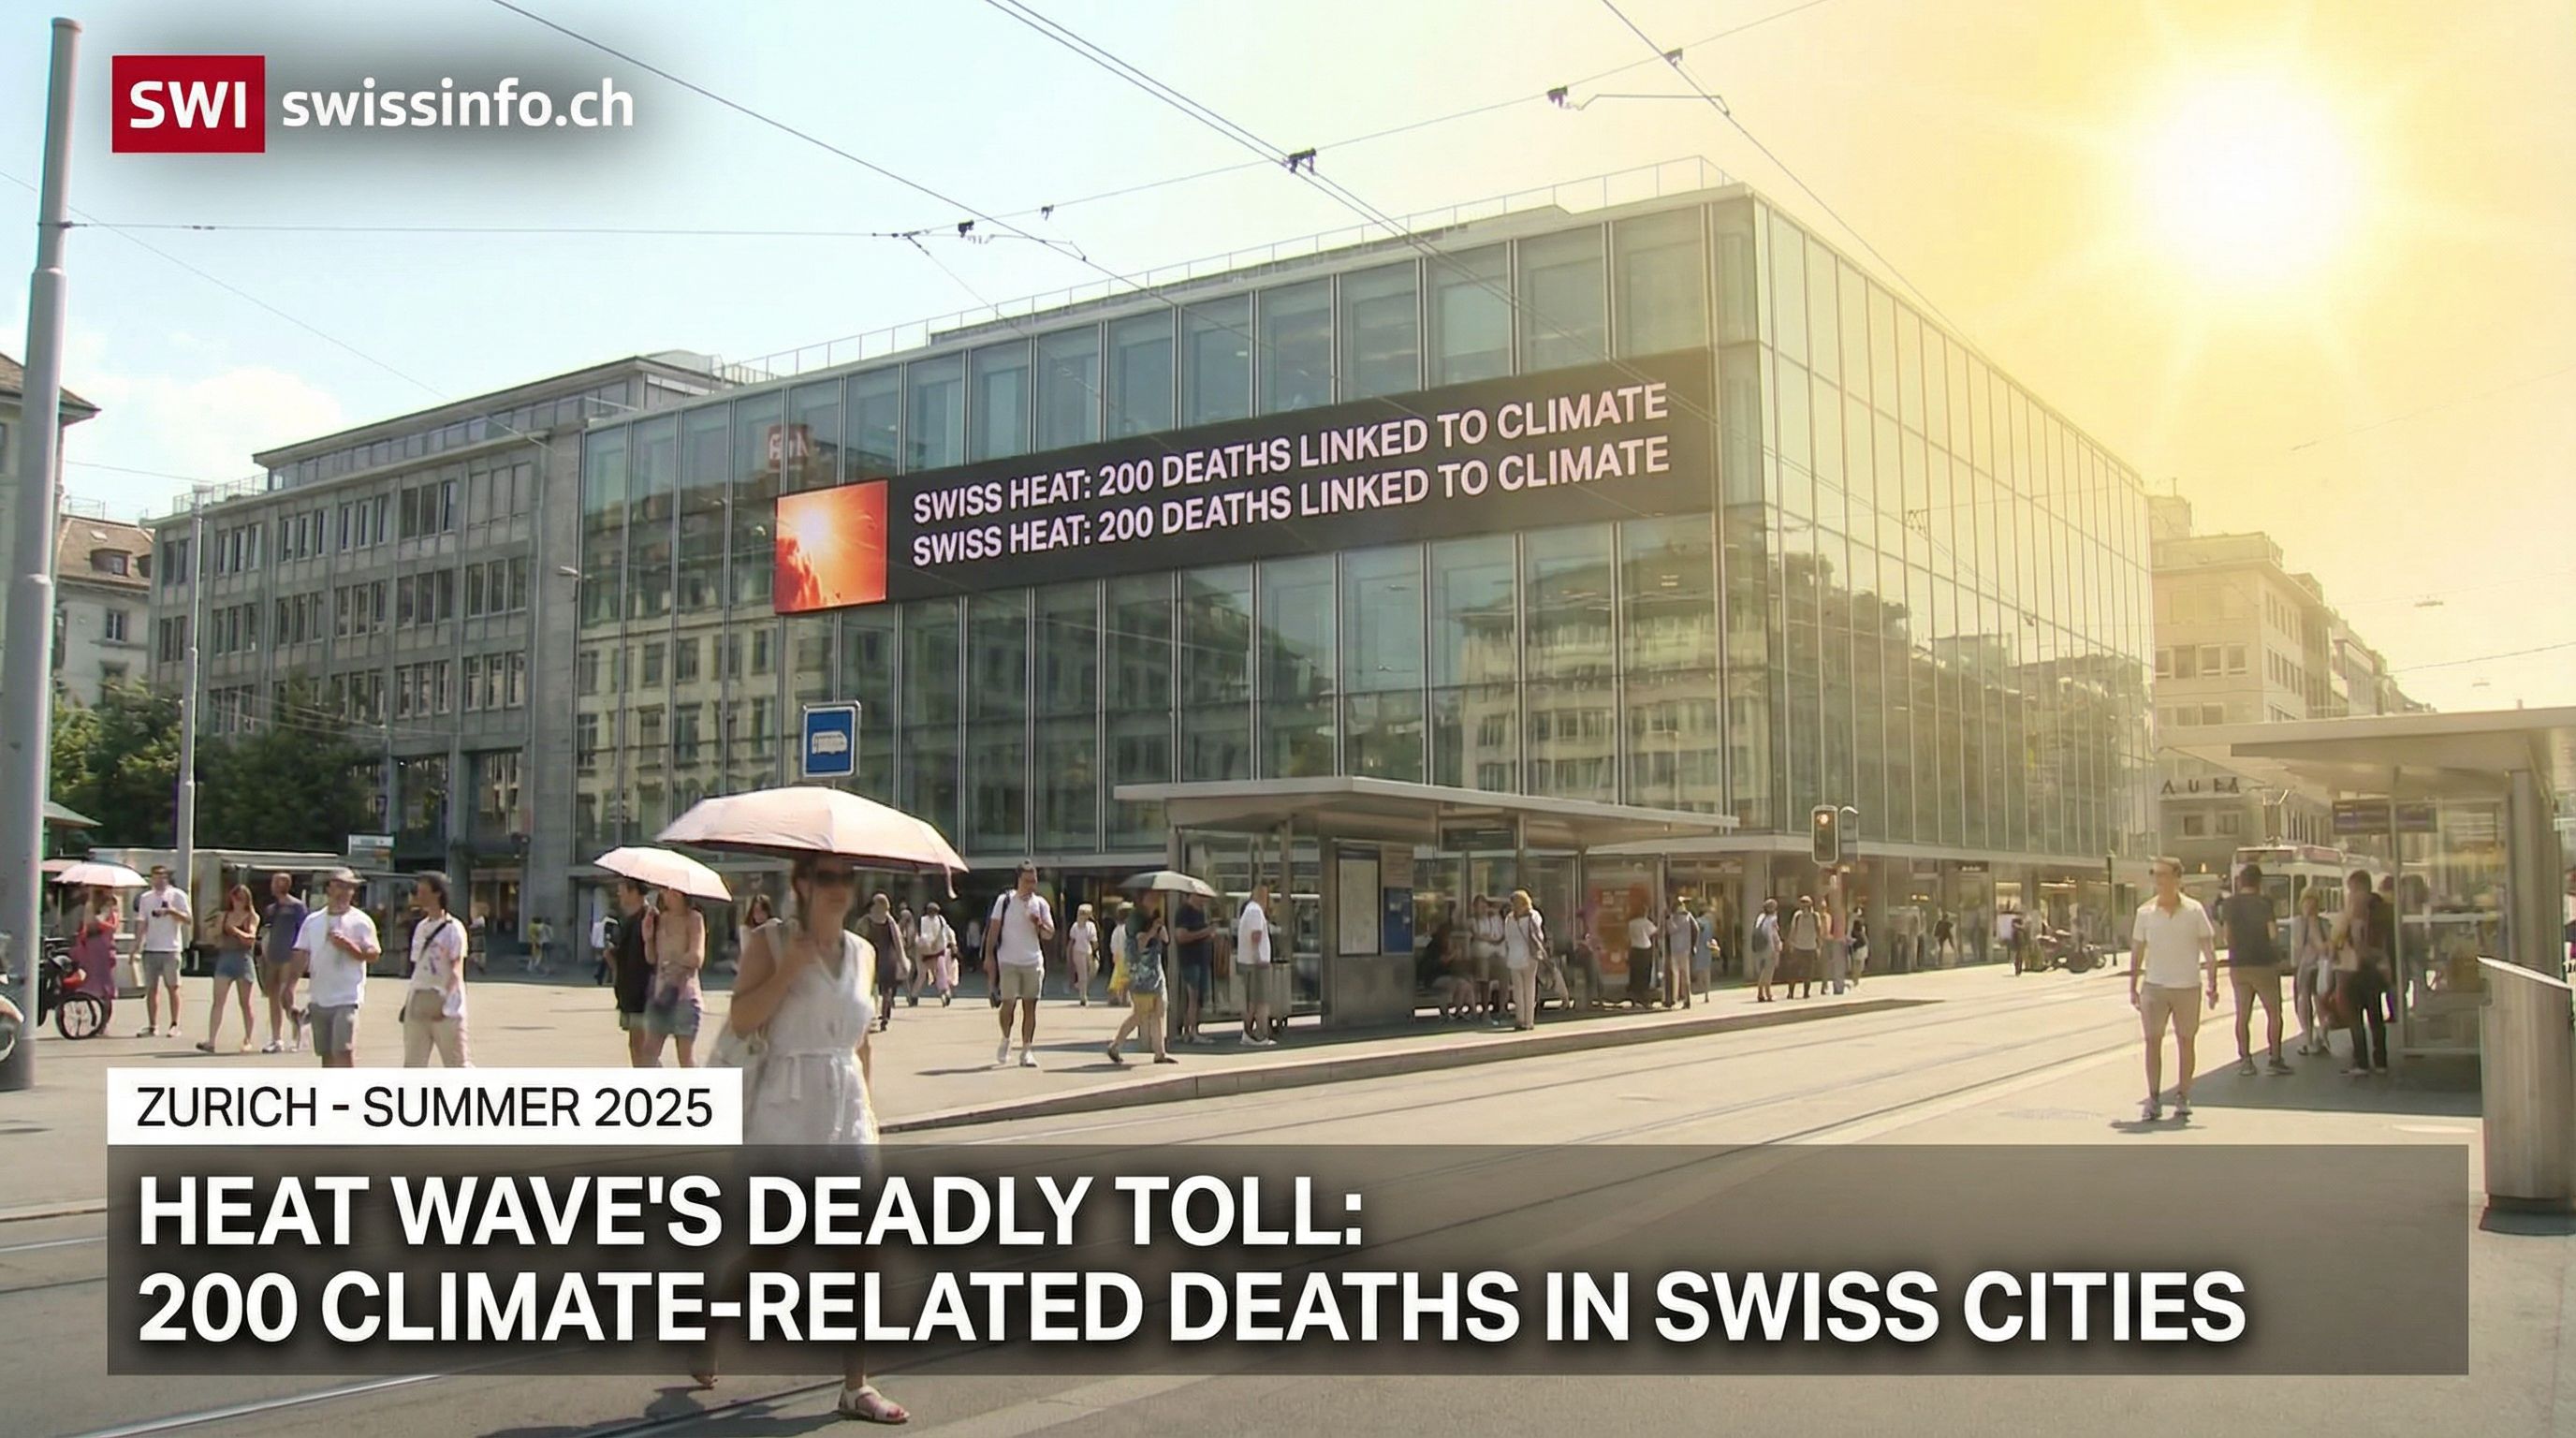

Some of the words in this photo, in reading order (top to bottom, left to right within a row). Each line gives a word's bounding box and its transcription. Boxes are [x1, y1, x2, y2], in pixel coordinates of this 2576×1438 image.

[914, 482, 1003, 523] SWISS
[1010, 469, 1091, 509] HEAT:
[1099, 460, 1153, 496] 200
[1163, 438, 1291, 487] DEATHS
[1300, 418, 1427, 467] LINKED
[1437, 409, 1487, 448] TO
[1498, 383, 1667, 439] CLIMATE
[914, 526, 1002, 565] SWISS
[1010, 515, 1091, 553] HEAT:
[1099, 506, 1153, 542] 200
[1163, 486, 1291, 534] DEATHS
[1301, 469, 1428, 516] LINKED
[1437, 460, 1488, 497] TO
[1499, 436, 1669, 491] CLIMATE
